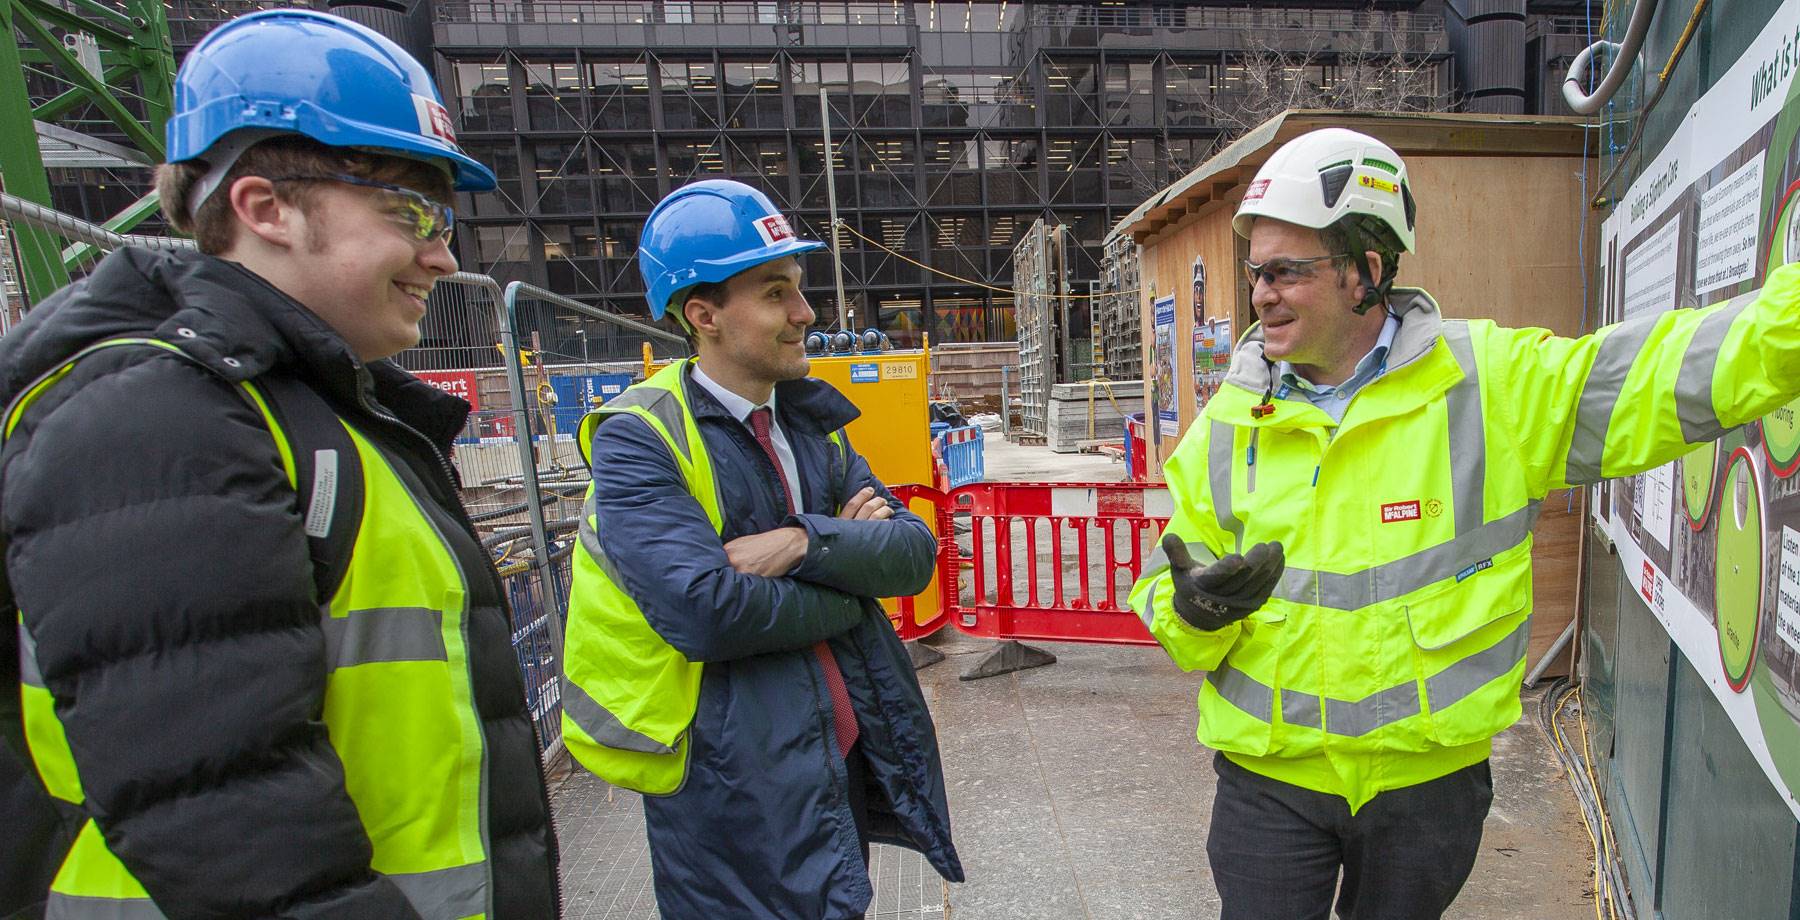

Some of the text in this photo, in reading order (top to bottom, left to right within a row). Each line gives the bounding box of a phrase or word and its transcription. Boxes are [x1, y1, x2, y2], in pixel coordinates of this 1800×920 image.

[1751, 48, 1779, 111] What
[1780, 34, 1791, 82] is
[886, 365, 913, 375] 29810
[428, 379, 467, 392] bert
[1384, 510, 1418, 520] McALPINE
[1783, 534, 1799, 556] Listen
[1782, 561, 1787, 575] of
[1787, 565, 1796, 582] the
